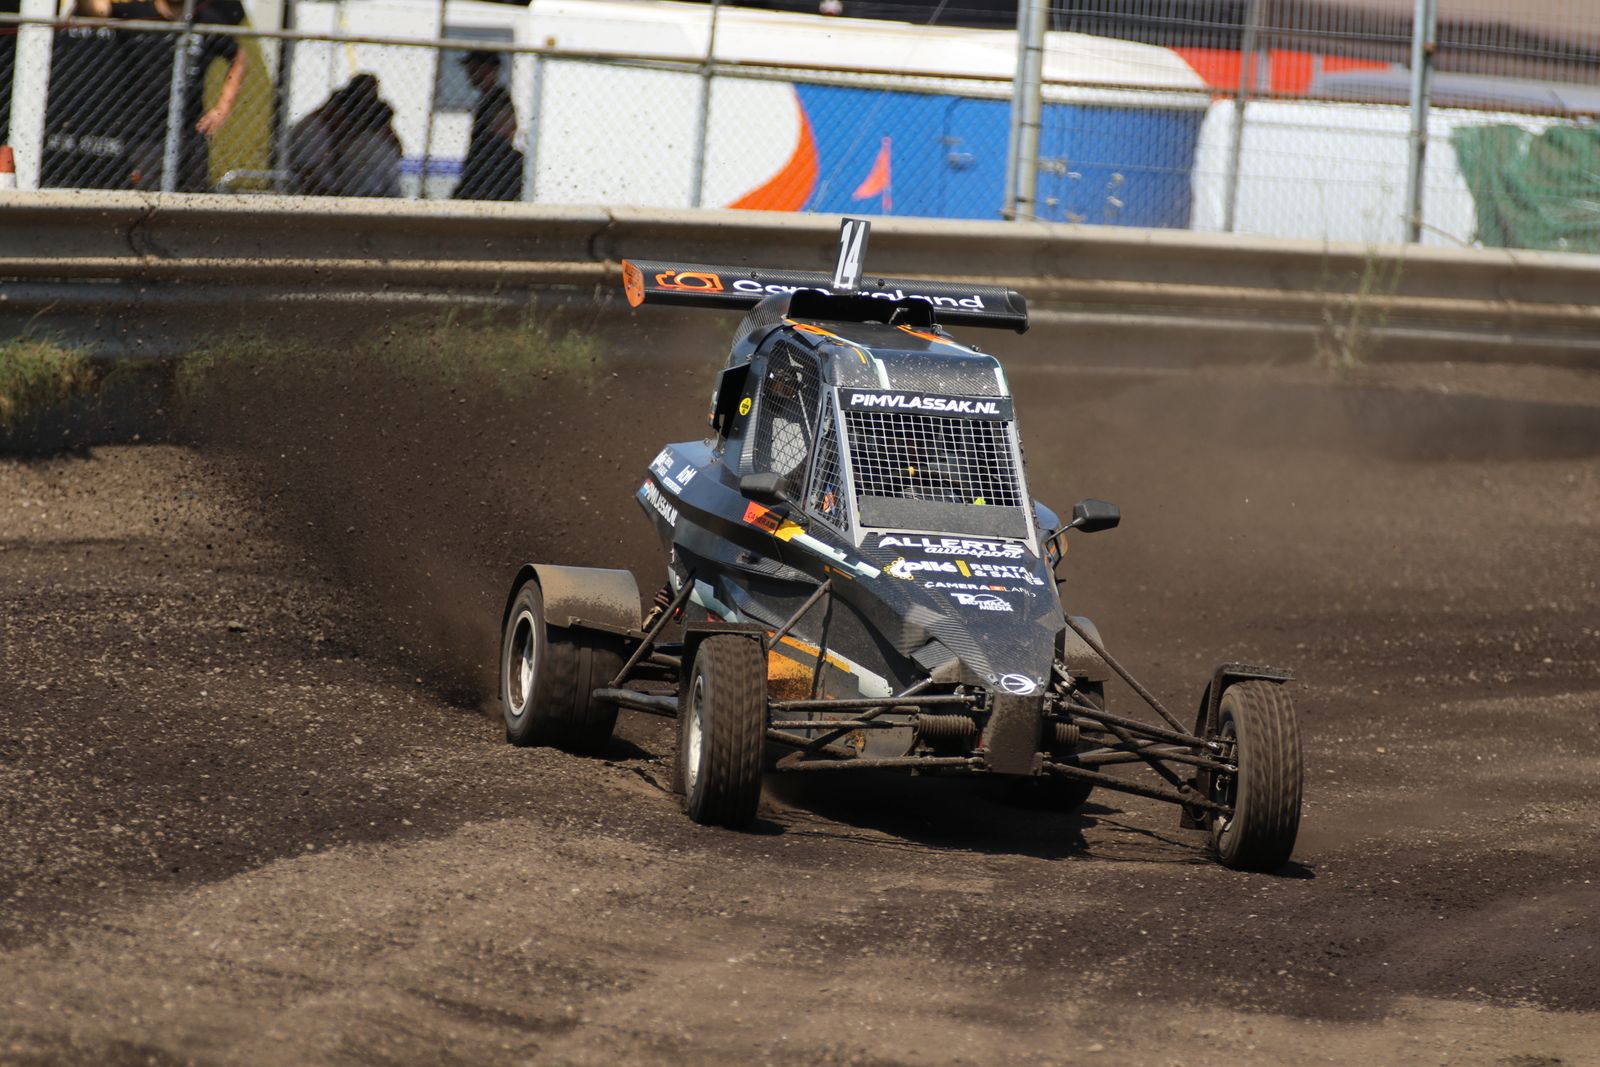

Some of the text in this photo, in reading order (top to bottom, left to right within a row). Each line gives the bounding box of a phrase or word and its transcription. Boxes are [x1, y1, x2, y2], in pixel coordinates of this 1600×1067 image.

[833, 221, 866, 290] 14
[733, 280, 985, 309] Caaland
[851, 393, 1000, 414] PIMVLASSAK.NL
[879, 536, 1025, 554] ALLERTS
[924, 547, 1022, 559] autosport
[979, 604, 1014, 612] MEDIA
